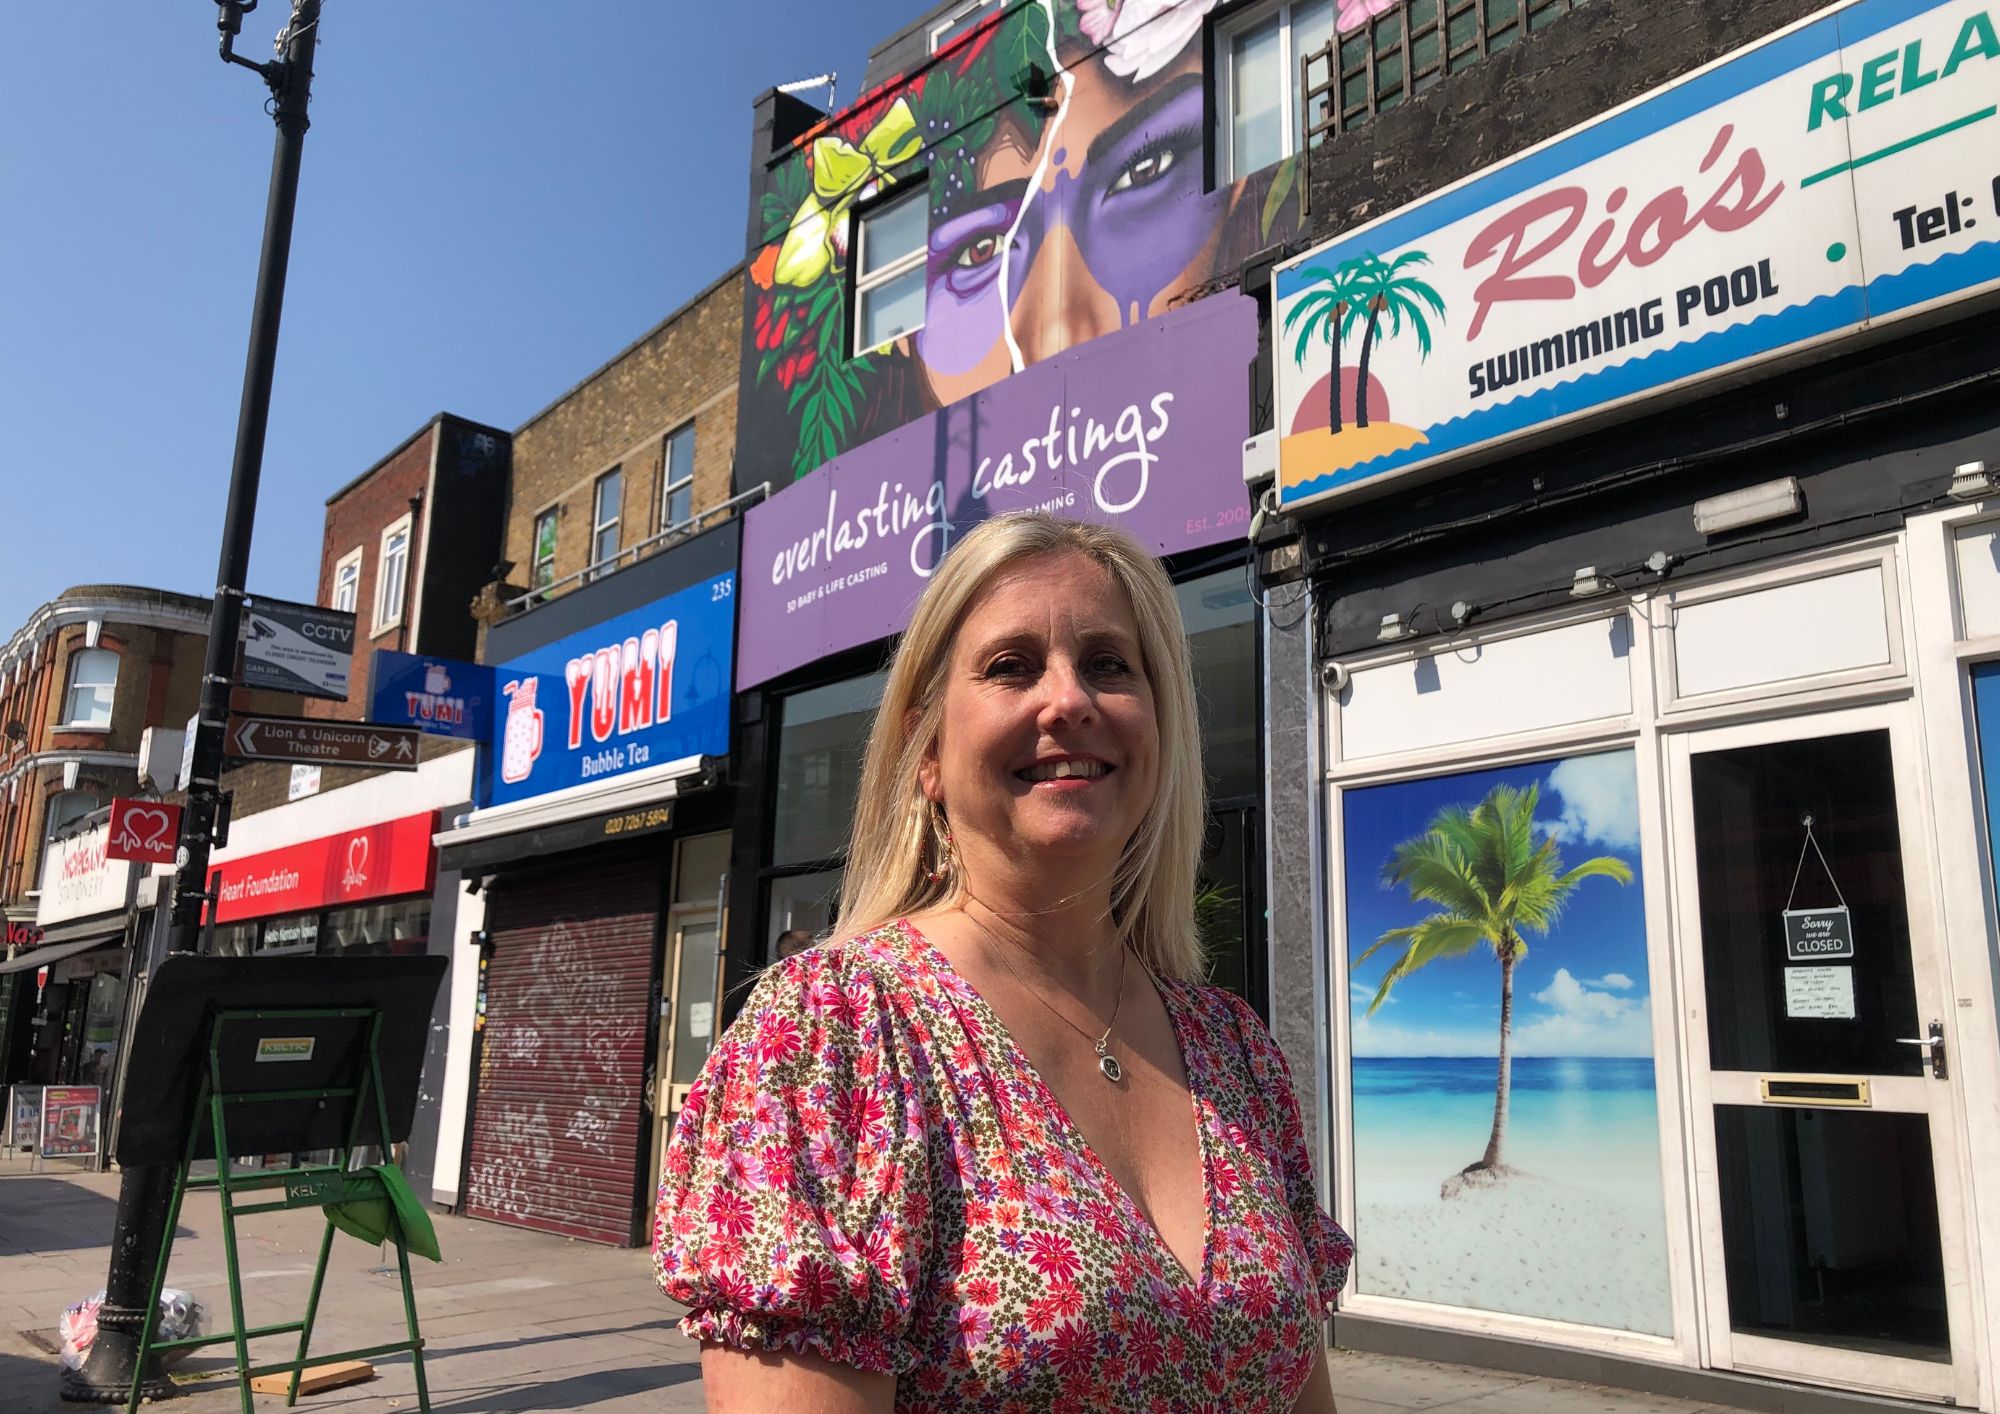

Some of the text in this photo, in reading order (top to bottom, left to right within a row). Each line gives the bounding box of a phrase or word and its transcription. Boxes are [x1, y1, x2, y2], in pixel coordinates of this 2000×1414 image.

[1463, 123, 1785, 342] Rio's
[1892, 190, 1976, 250] Tel:
[1468, 258, 1779, 399] SWIMMING POOL
[772, 391, 1174, 585] everlasting castings
[1186, 516, 1212, 534] Est.
[711, 578, 732, 602] 235
[786, 561, 888, 613] 3D BABY & LIFE CASTING
[302, 622, 353, 643] CCTV
[565, 619, 678, 750] YUMI
[405, 691, 465, 724] YUMI
[265, 725, 365, 744] Lion & Unicorn
[287, 741, 341, 756] Theatre
[581, 742, 650, 778] Bubble Tea
[220, 869, 299, 902] Heart Foundation
[1801, 916, 1834, 932] Sorry
[1797, 939, 1843, 952] CLOSED
